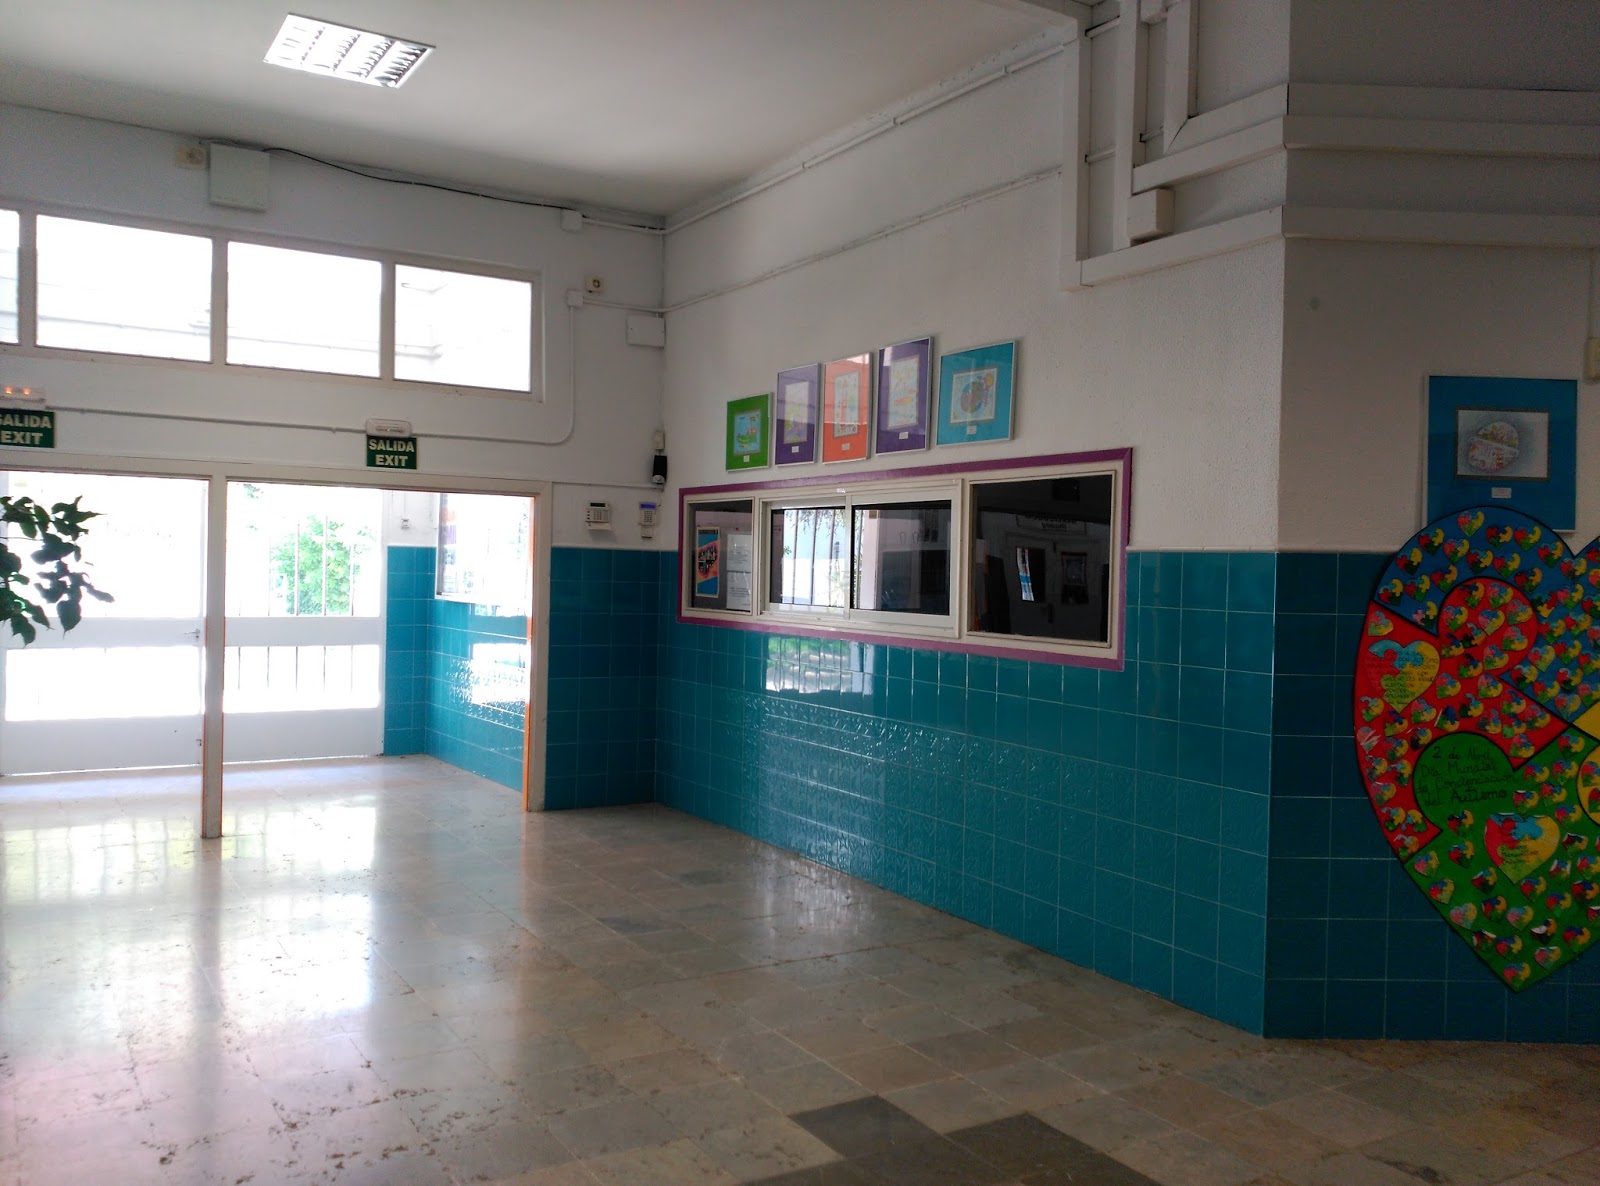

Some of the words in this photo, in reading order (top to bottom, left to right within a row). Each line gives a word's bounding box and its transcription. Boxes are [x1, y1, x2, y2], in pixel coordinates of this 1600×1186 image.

[1, 431, 43, 444] EXIT
[369, 439, 415, 452] SALIDA
[376, 455, 408, 466] EXIT
[1432, 746, 1441, 758] 2
